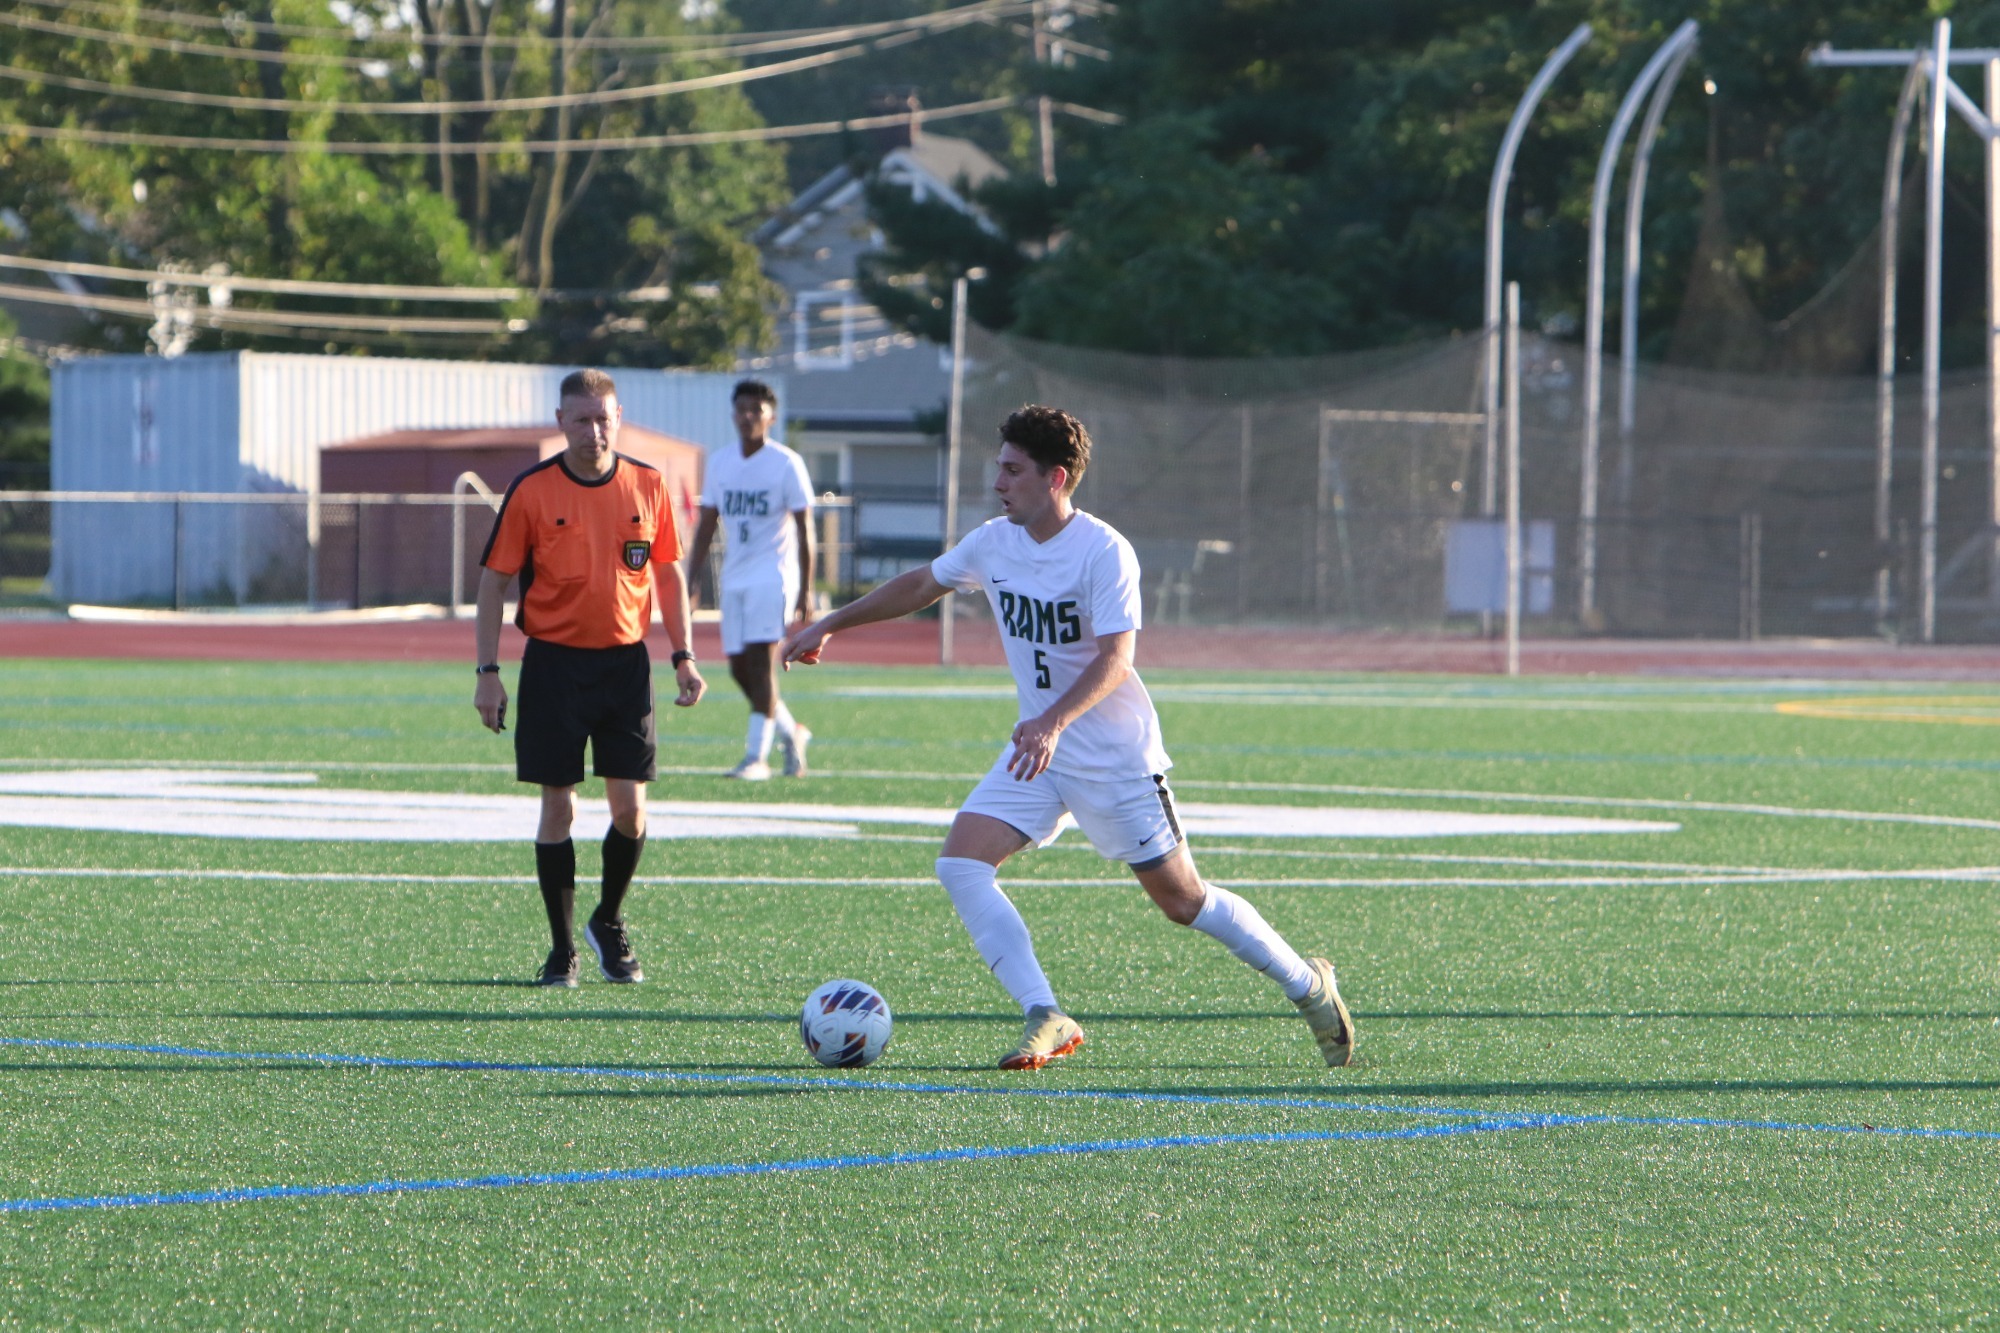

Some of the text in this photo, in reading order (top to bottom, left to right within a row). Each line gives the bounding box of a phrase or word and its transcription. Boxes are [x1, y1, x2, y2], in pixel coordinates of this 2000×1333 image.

[723, 490, 769, 516] RAMS
[999, 590, 1081, 645] RAMS
[1034, 649, 1051, 689] 5
